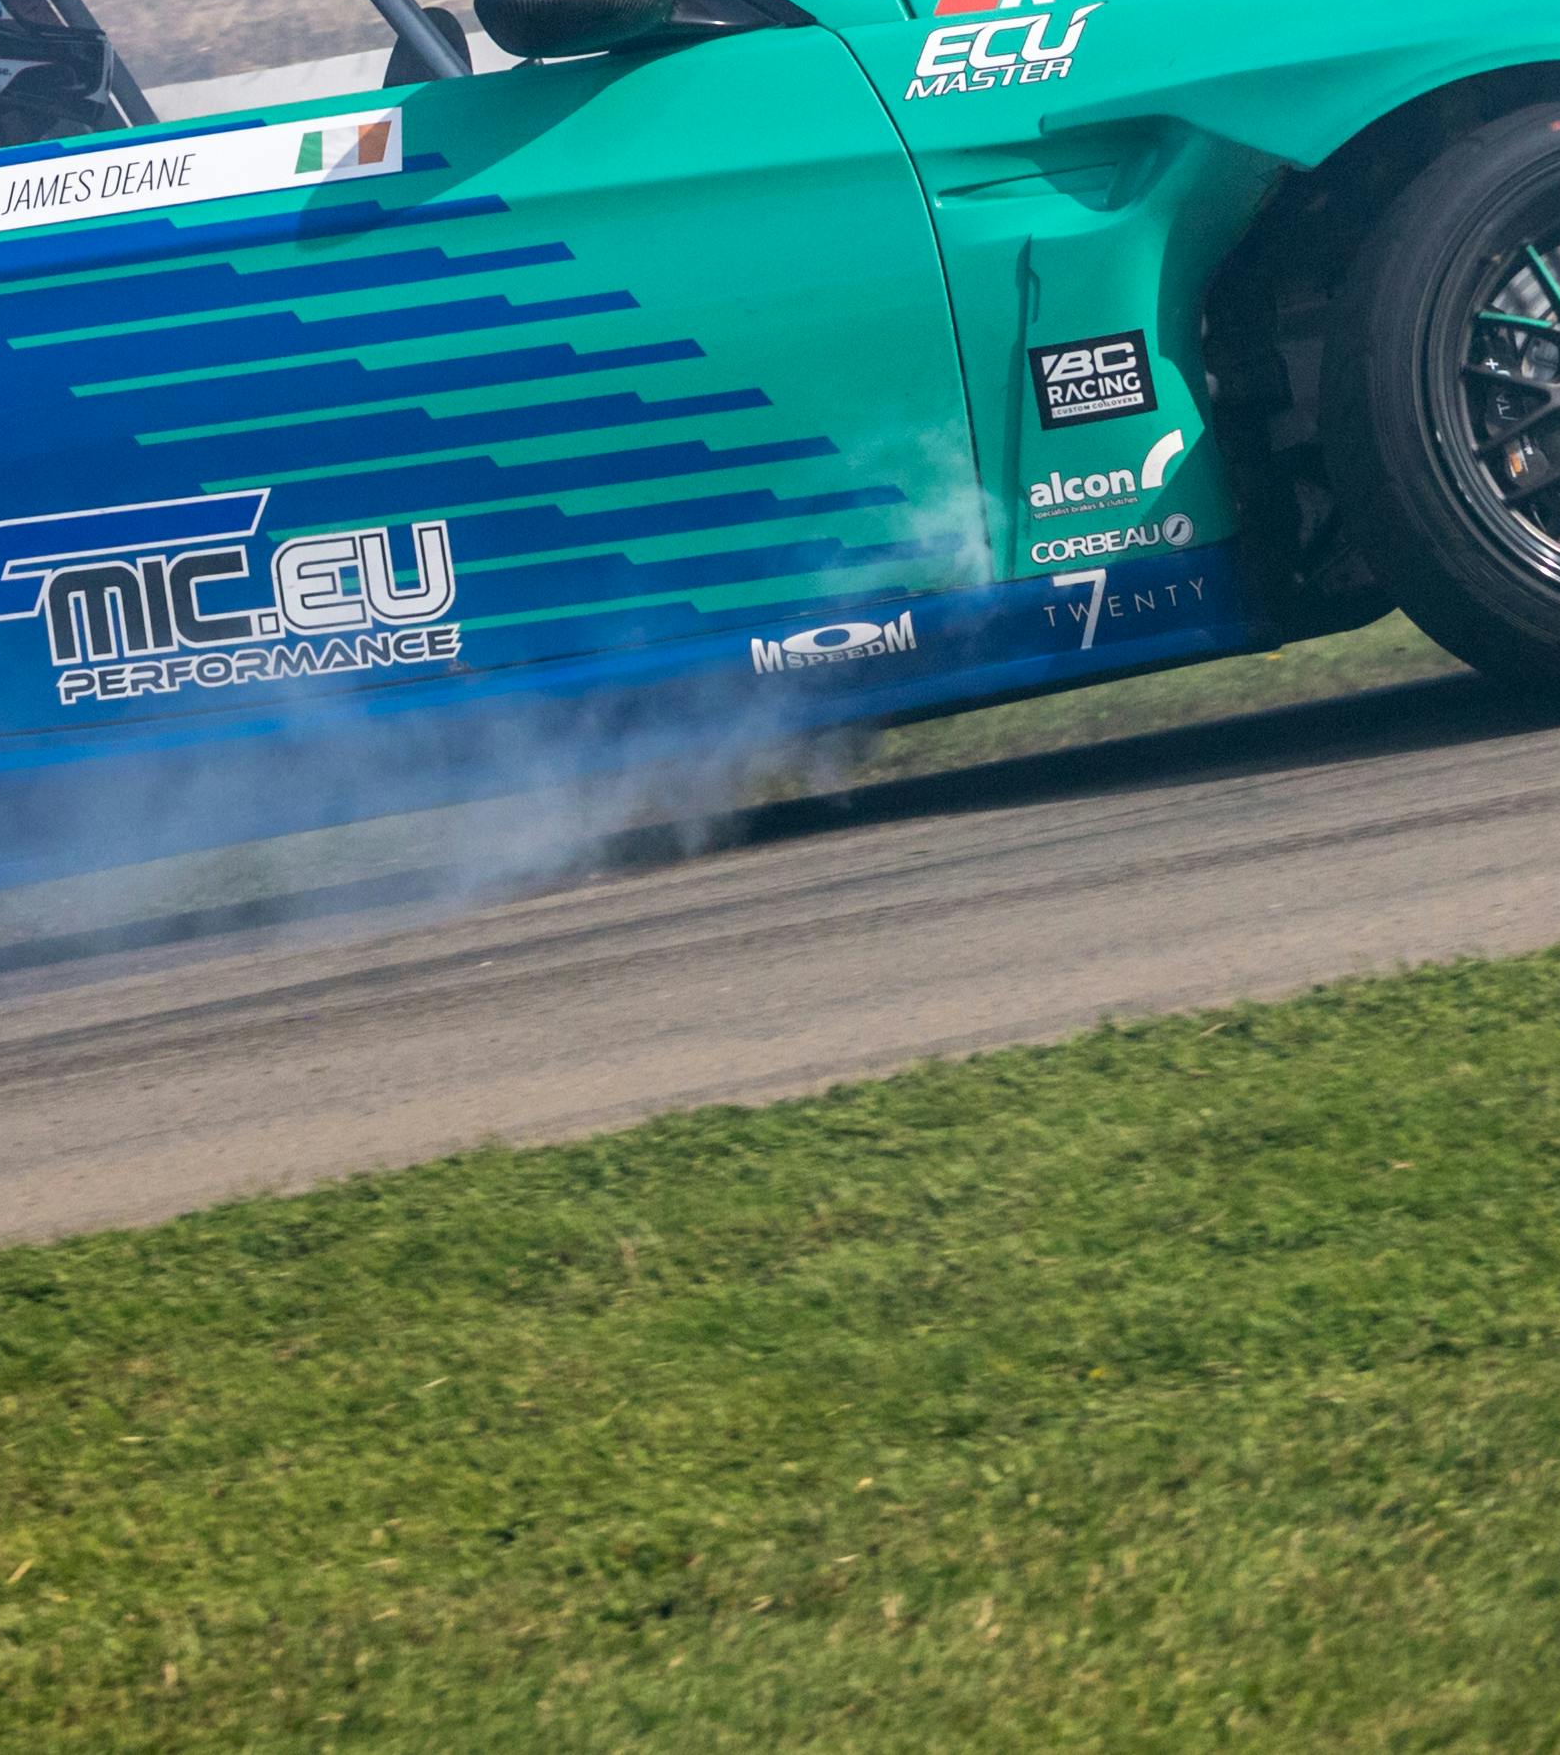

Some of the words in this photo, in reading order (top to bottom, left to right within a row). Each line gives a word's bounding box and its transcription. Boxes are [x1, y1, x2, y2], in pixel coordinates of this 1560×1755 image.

[914, 0, 1108, 78] ECU
[903, 57, 1074, 101] MASTER
[1, 169, 95, 216] JAMES
[100, 153, 197, 199] DEANE
[1042, 341, 1137, 383] BC
[1047, 372, 1141, 405] RACING
[1056, 405, 1090, 416] CUSTOM
[1092, 396, 1138, 411] COILOVERS
[1030, 468, 1136, 508] alcon
[1033, 507, 1070, 520] specialist
[1071, 503, 1096, 513] brakes
[1107, 496, 1139, 507] clutches
[1031, 523, 1160, 564] CORBEAU
[1043, 576, 1204, 628] TWENTY
[59, 622, 463, 705] PERFORMANCE
[786, 641, 885, 669] SPEED
